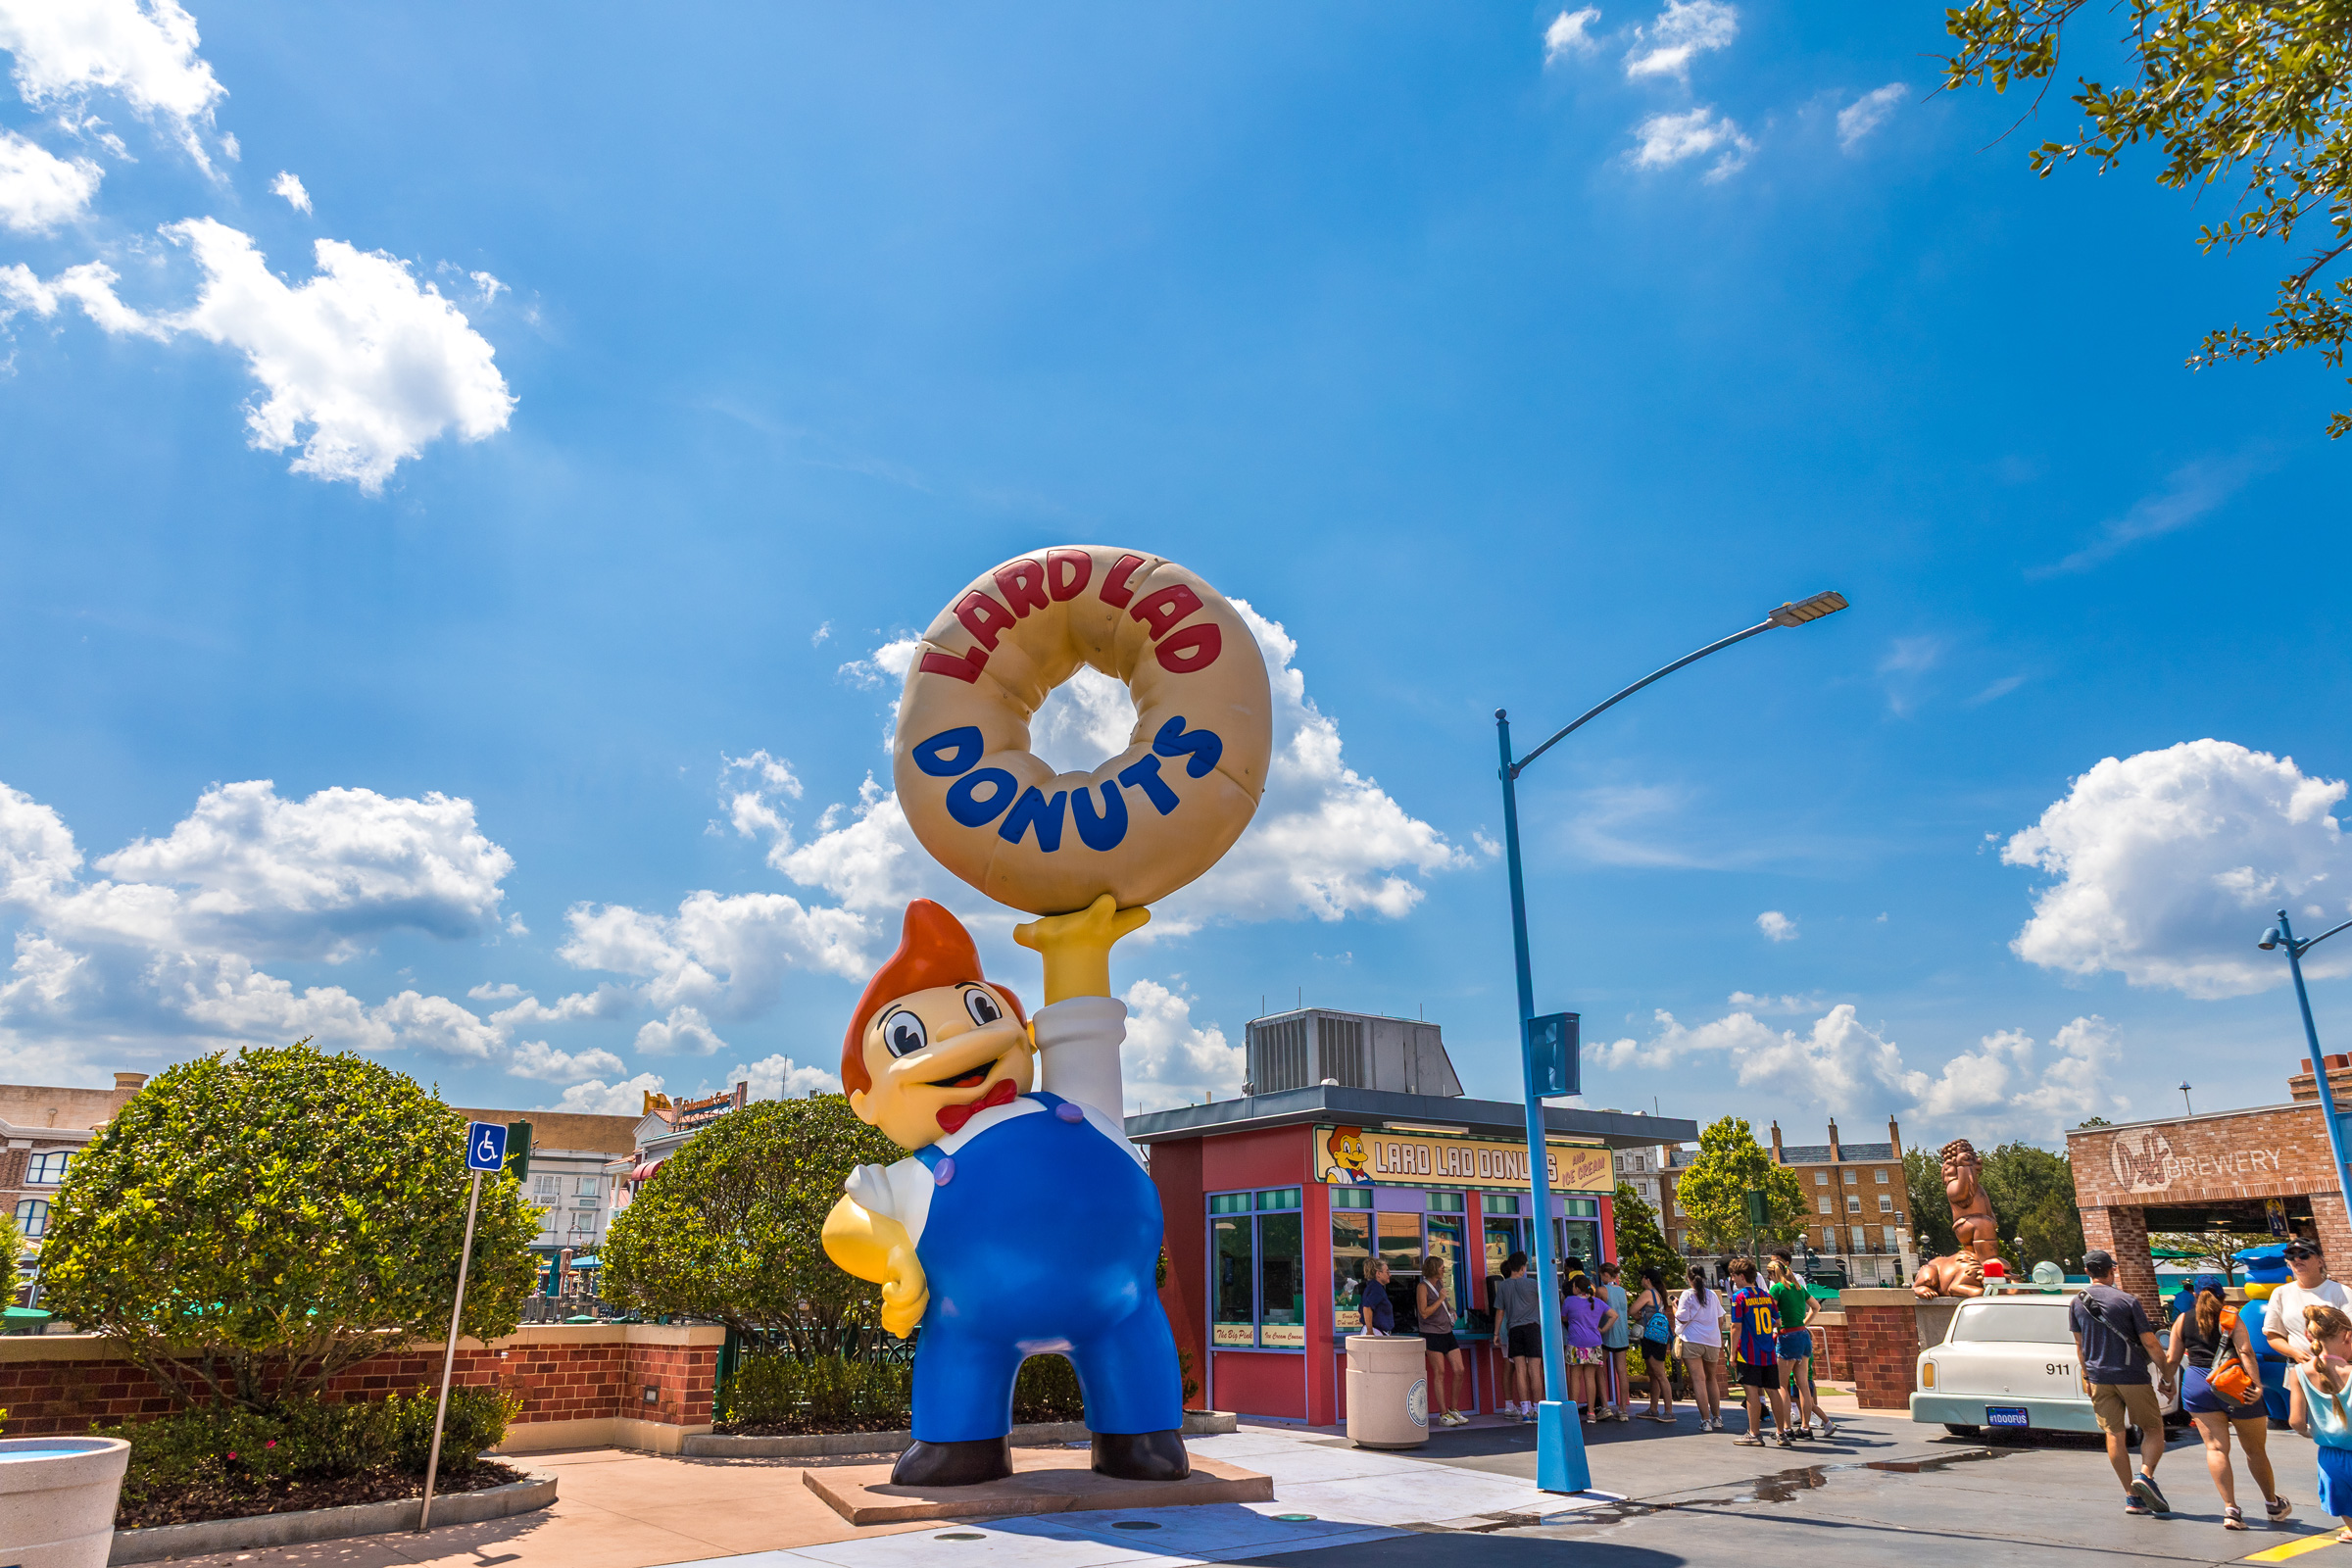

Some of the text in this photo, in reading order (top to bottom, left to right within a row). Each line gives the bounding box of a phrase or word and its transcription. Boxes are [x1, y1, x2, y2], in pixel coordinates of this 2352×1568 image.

[919, 549, 1222, 684] LARD LAD
[912, 715, 1223, 853] DONUTS
[1374, 1141, 1558, 1183] LARD LAD DONUS
[1562, 1156, 1605, 1188] ICE CREAM
[1572, 1152, 1586, 1166] AND
[2116, 1128, 2281, 1193] Duff BREWERY
[1216, 1329, 1253, 1342] The Big Pink
[1753, 1306, 1773, 1335] 10
[2045, 1363, 2070, 1375] 911
